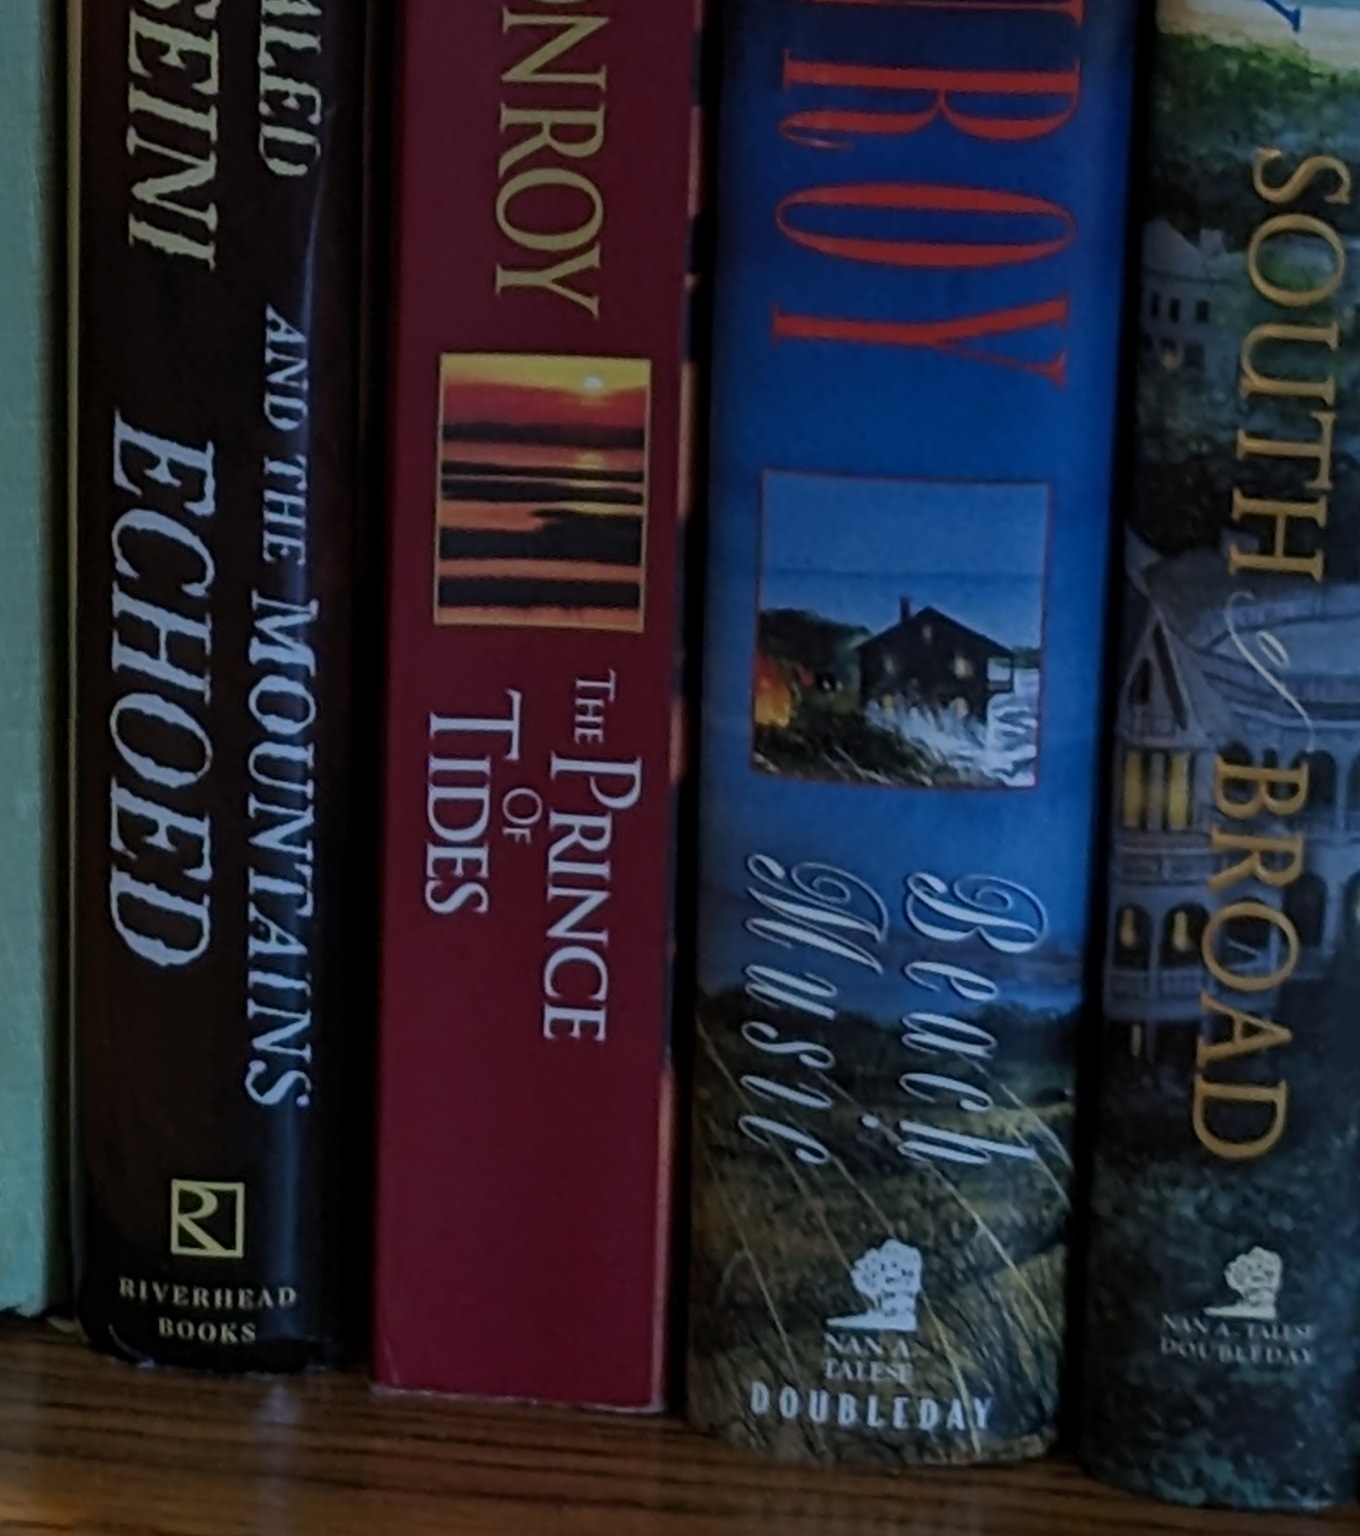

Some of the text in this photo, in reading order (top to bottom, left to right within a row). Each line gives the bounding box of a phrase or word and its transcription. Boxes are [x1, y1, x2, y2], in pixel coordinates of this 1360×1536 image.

[1228, 147, 1352, 583] SOUTH
[109, 408, 216, 967] ECHOED
[245, 304, 319, 1107] AND THE MOUNTAINS
[424, 688, 522, 916] TIDES
[501, 787, 543, 844] OF
[543, 669, 643, 1042] THE PRINCE
[1191, 753, 1310, 1161] BROAD
[738, 853, 889, 1164] Music
[897, 870, 1049, 1164] Beach
[118, 1275, 298, 1311] RIVERHEAD
[158, 1316, 257, 1345] BOOKS
[751, 1381, 993, 1432] DOUBLEDAY
